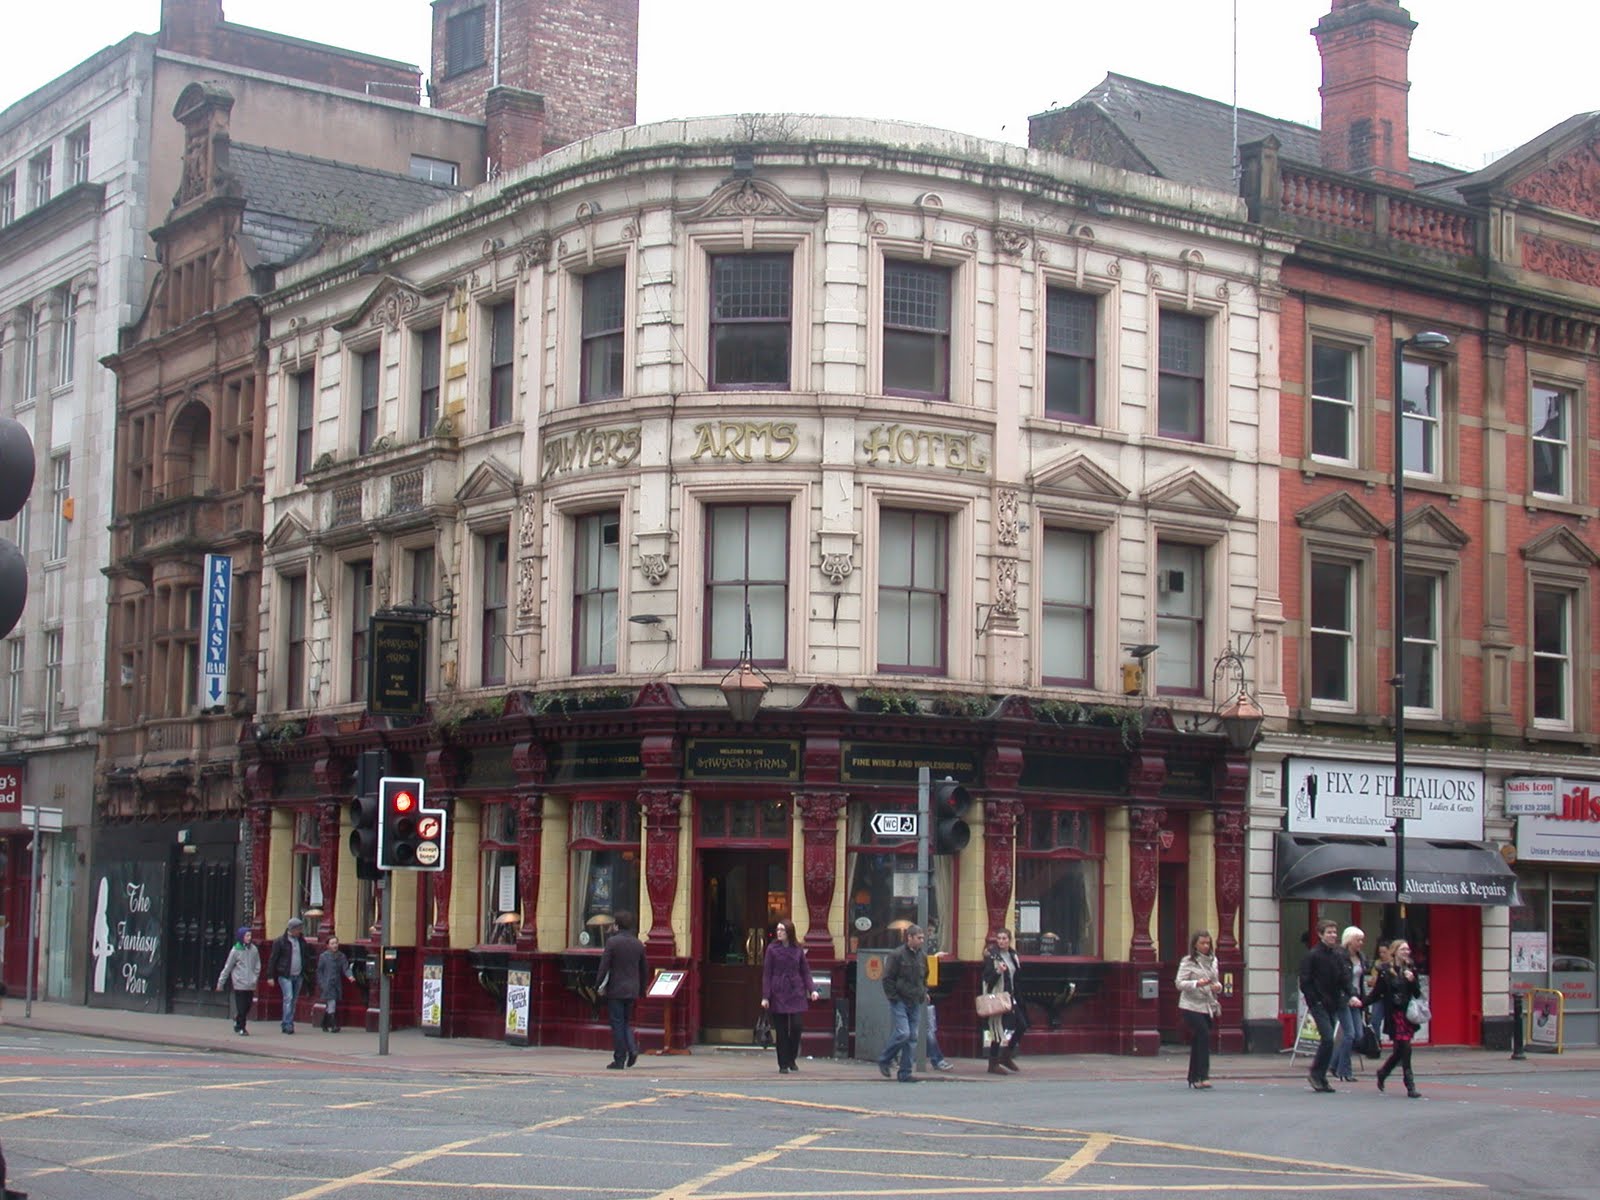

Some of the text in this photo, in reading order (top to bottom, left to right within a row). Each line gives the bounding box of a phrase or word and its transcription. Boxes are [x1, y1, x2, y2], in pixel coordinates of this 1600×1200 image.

[541, 422, 988, 482] SAWYERS ARMS HOTEL
[211, 559, 227, 660] FANTASY
[206, 662, 225, 674] BAR
[754, 758, 788, 769] ARMS
[852, 757, 870, 767] FINE
[872, 758, 896, 768] WINES
[897, 759, 913, 768] AND
[1326, 771, 1353, 794] FIX
[1359, 773, 1369, 795] 2
[1405, 776, 1476, 802] TAILORS
[1507, 782, 1553, 792] Nails Icon
[1392, 798, 1415, 807] BRIDGE
[1429, 802, 1474, 813] Ladies & Gents
[1392, 808, 1415, 817] STREET
[885, 817, 897, 828] WC
[419, 845, 437, 853] Except
[1530, 847, 1550, 856] Unisex
[1551, 848, 1586, 857] Professional
[1353, 877, 1507, 898] Tailorin Alterations & Repairs
[126, 882, 150, 912] The
[117, 921, 158, 962] Fantasy
[122, 963, 148, 994] Bar
